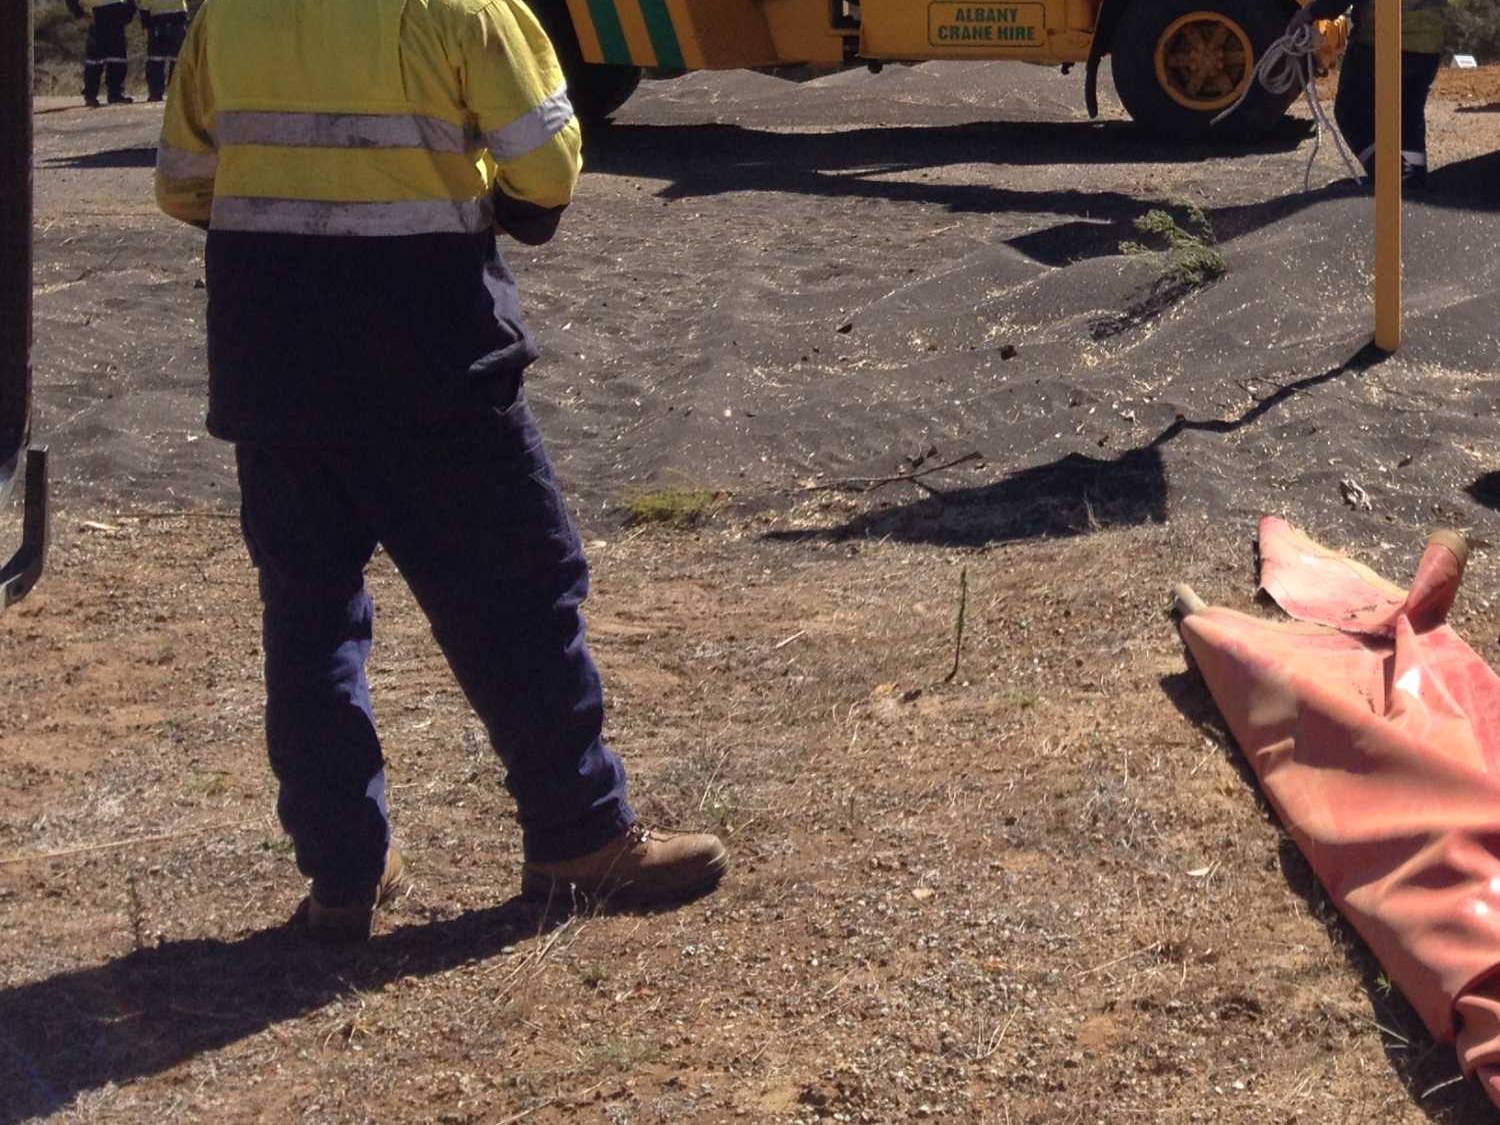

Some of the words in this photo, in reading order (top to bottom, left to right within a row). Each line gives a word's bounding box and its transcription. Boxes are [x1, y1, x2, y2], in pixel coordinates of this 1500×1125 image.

[955, 8, 1018, 22] ALBANY
[938, 26, 993, 40] CRANE
[998, 26, 1037, 40] HIRE
